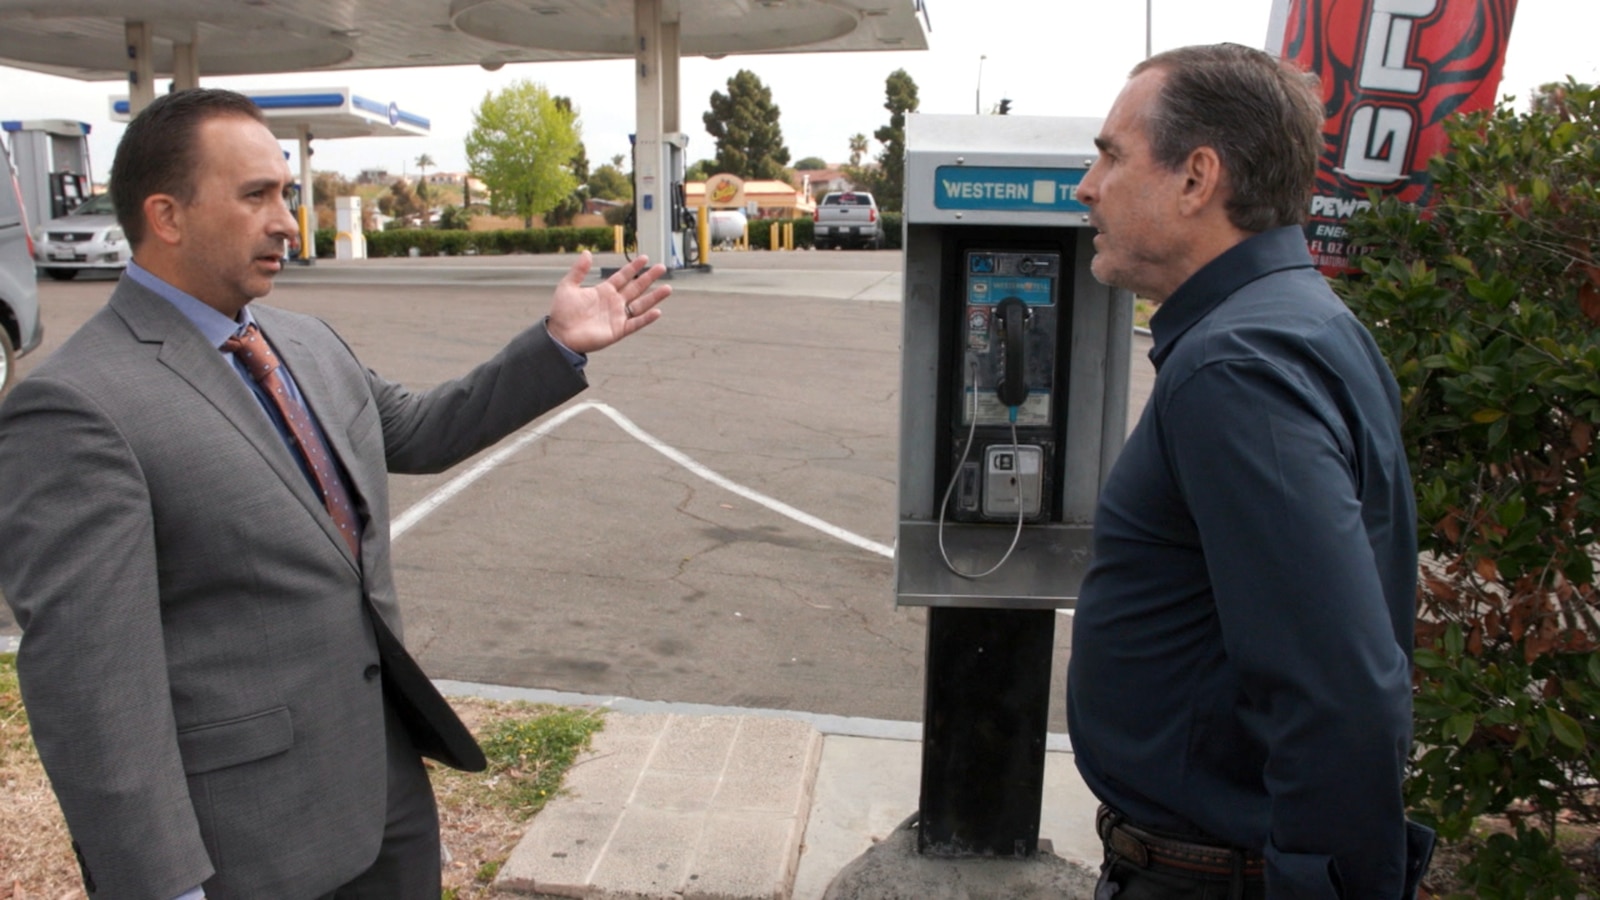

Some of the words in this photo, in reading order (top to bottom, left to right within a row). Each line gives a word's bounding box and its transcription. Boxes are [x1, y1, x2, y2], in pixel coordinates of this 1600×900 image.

[1343, 0, 1437, 183] GF
[943, 180, 1029, 200] WESTERN
[1059, 184, 1078, 201] TE
